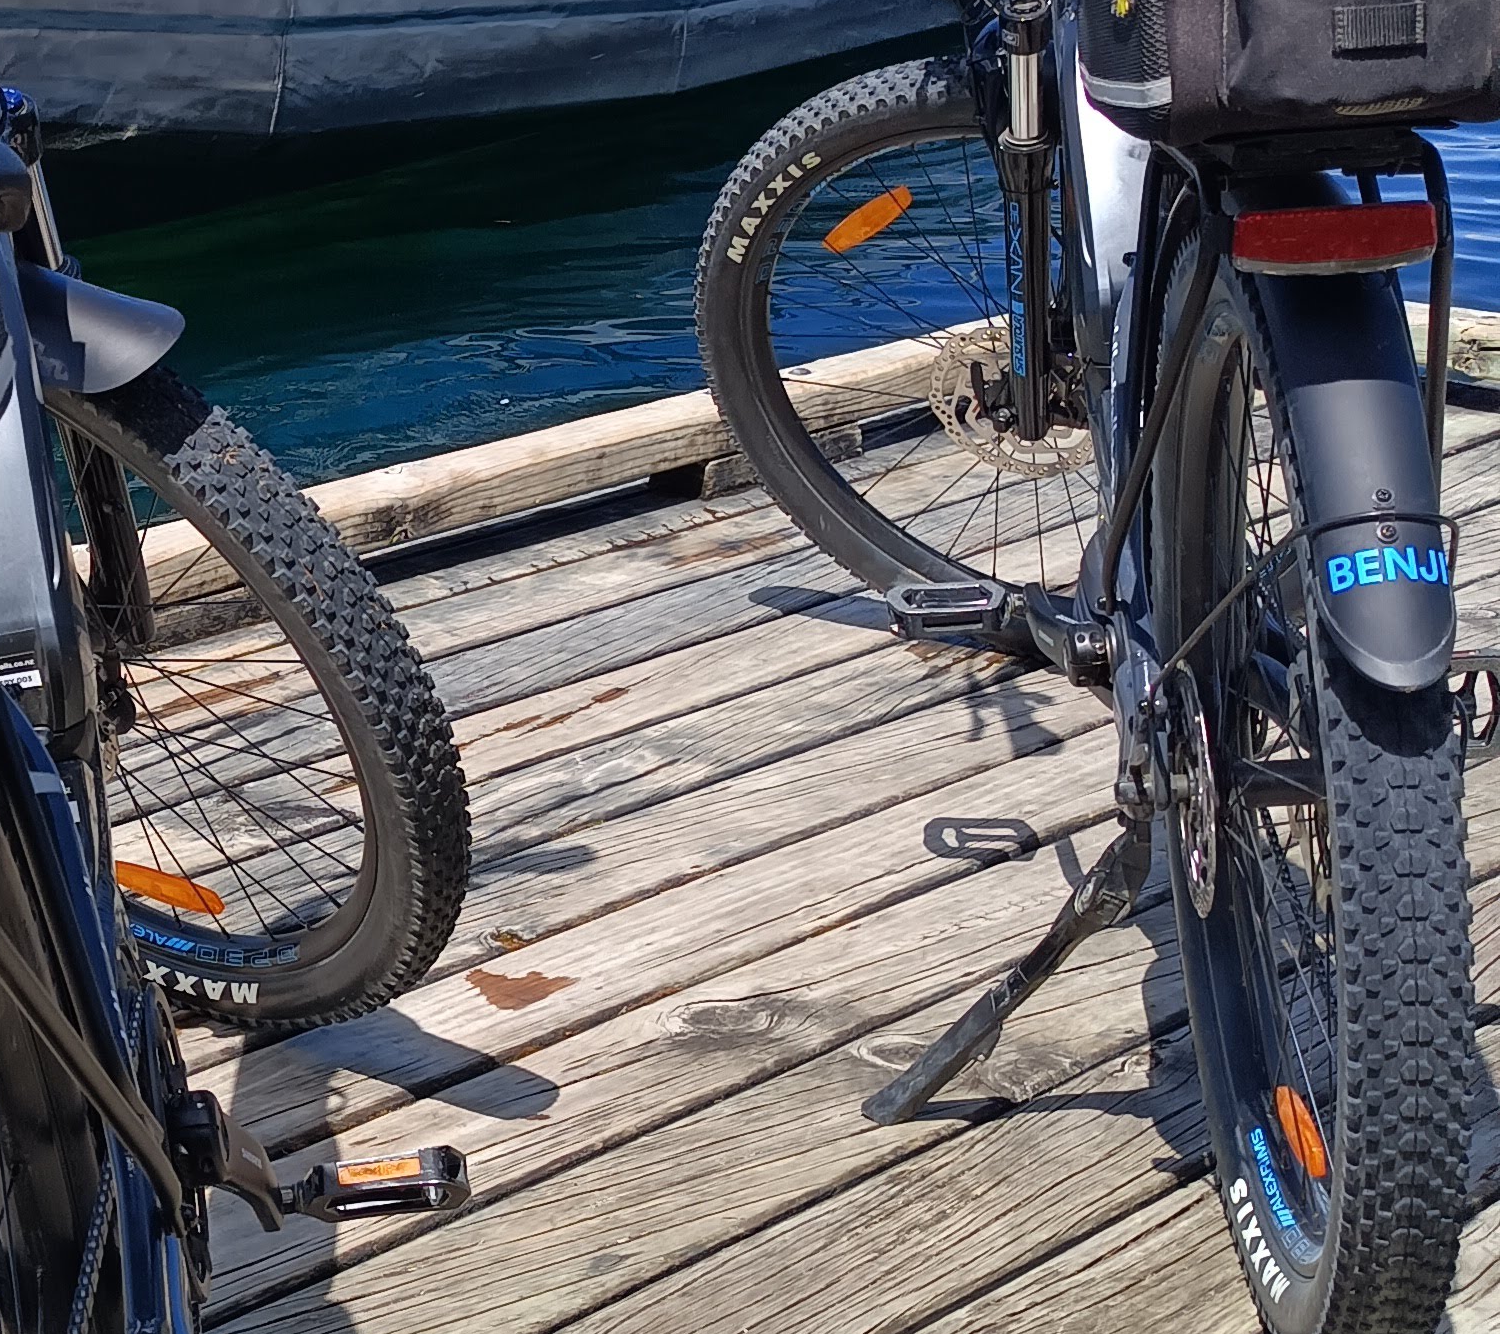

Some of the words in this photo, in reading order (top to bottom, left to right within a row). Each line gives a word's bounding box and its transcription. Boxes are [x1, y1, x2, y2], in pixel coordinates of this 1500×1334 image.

[726, 151, 823, 264] MAXXIS
[1328, 546, 1449, 594] BENJI
[143, 959, 260, 1005] MAXX
[1250, 1128, 1285, 1212] ALEXRIMS
[1230, 1178, 1292, 1304] MAXXIS
